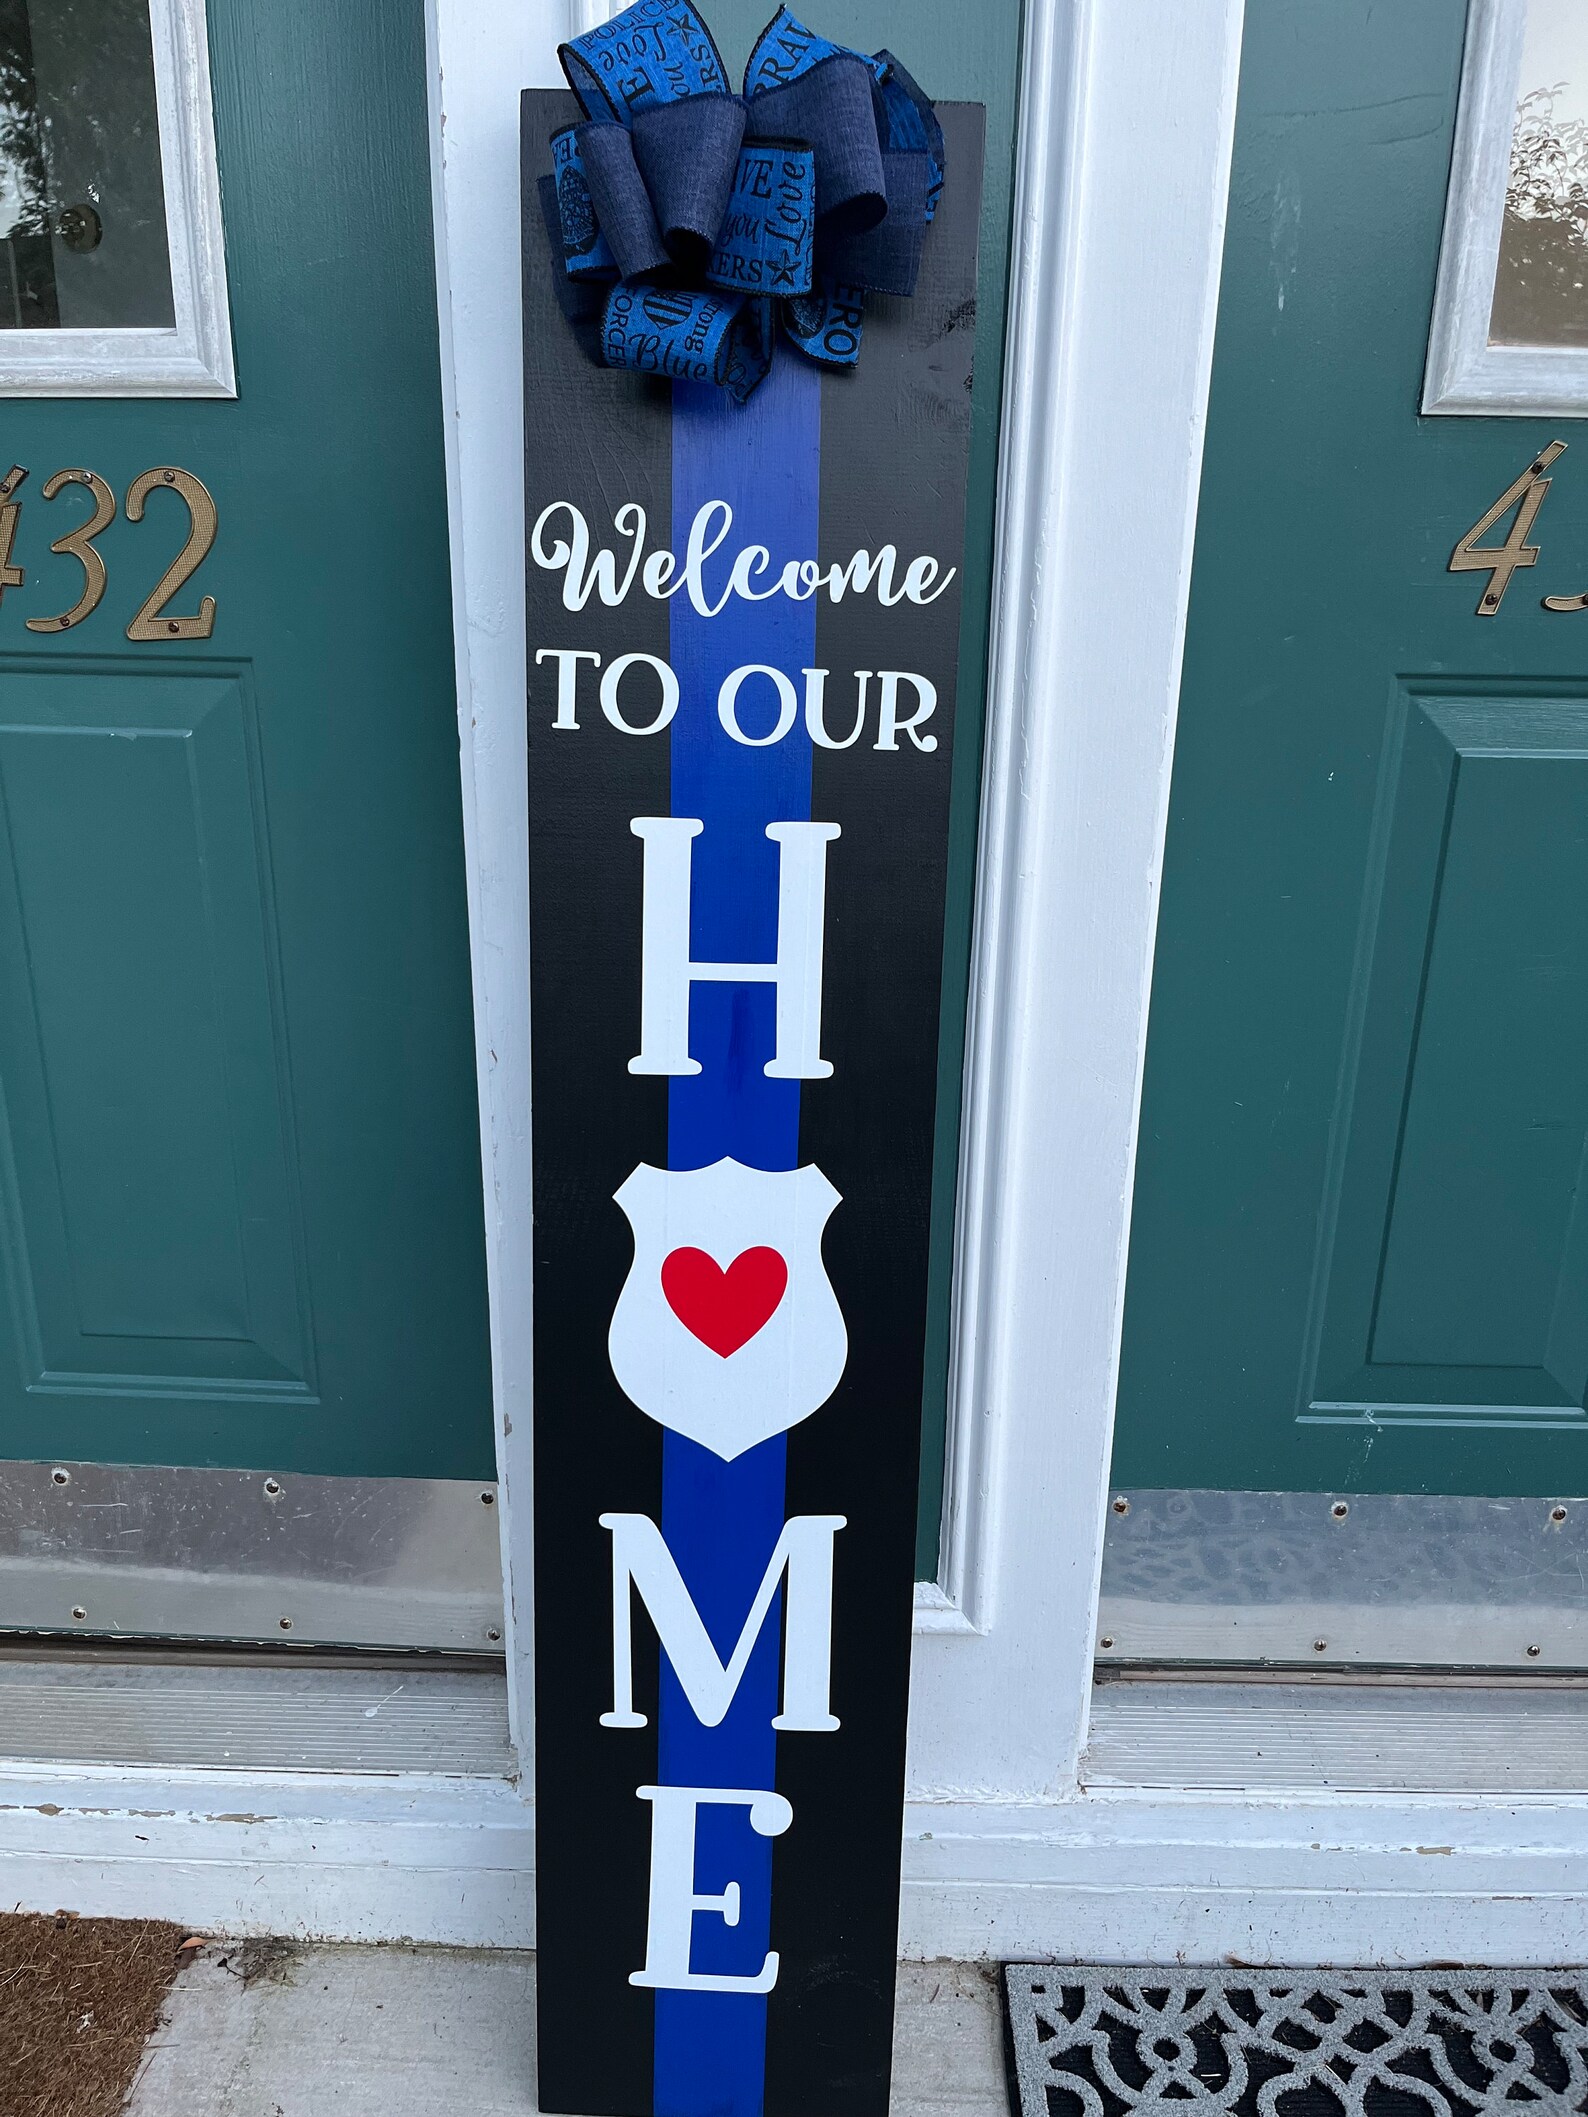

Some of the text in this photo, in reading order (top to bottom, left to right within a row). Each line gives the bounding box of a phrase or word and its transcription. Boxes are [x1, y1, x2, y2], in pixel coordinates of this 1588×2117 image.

[577, 0, 680, 52] POLICE
[598, 22, 665, 71] Love
[731, 159, 774, 199] VE
[720, 213, 760, 247] you
[764, 161, 807, 256] Love
[628, 333, 708, 382] Blue
[1448, 440, 1588, 616] 4
[531, 500, 957, 618] Welcome
[535, 649, 939, 753] TO OUR
